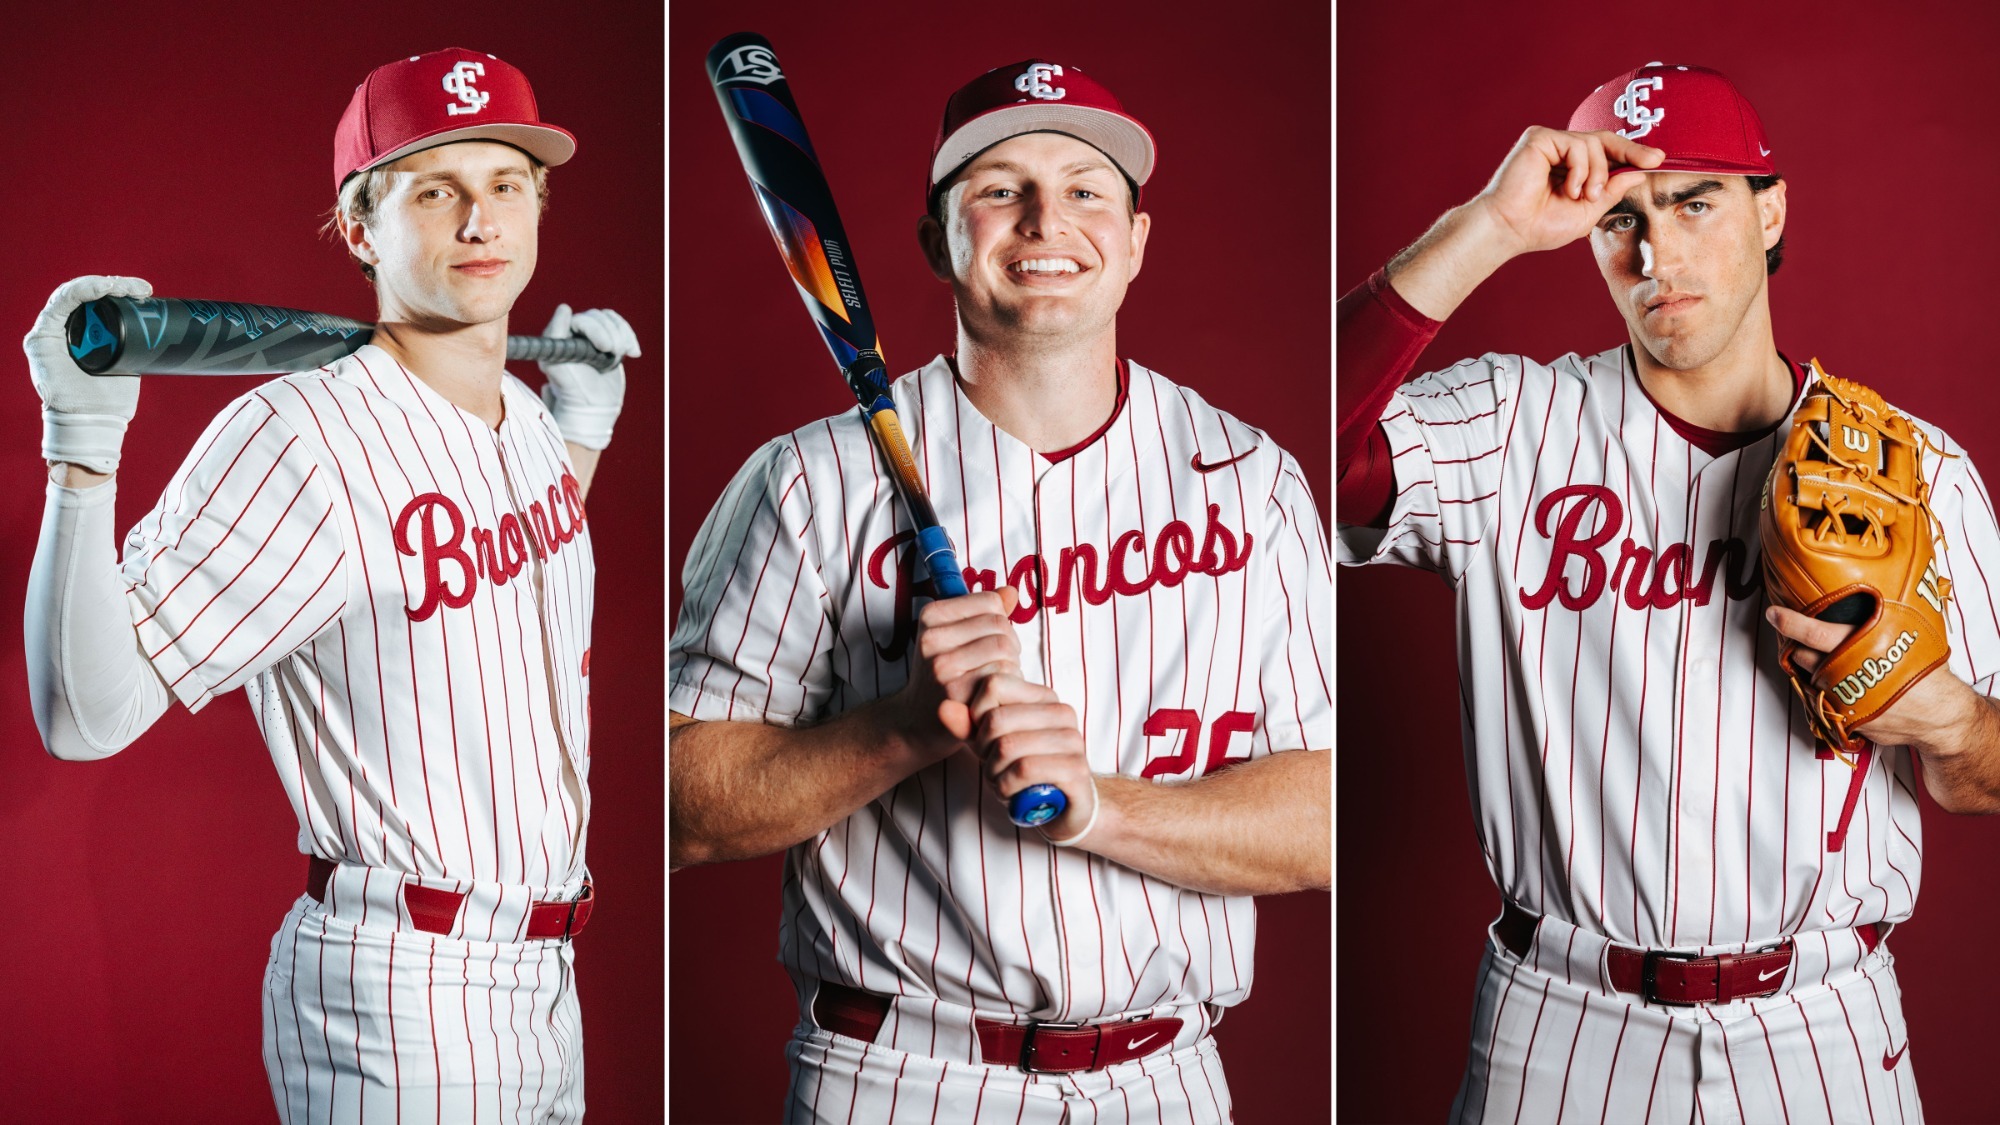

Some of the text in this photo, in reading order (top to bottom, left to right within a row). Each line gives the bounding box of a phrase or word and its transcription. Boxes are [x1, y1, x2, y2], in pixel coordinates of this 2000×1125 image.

[834, 269, 861, 309] SELECT
[394, 461, 586, 622] Bronco
[1519, 484, 1766, 611] Bron
[1832, 630, 1916, 706] Wilson
